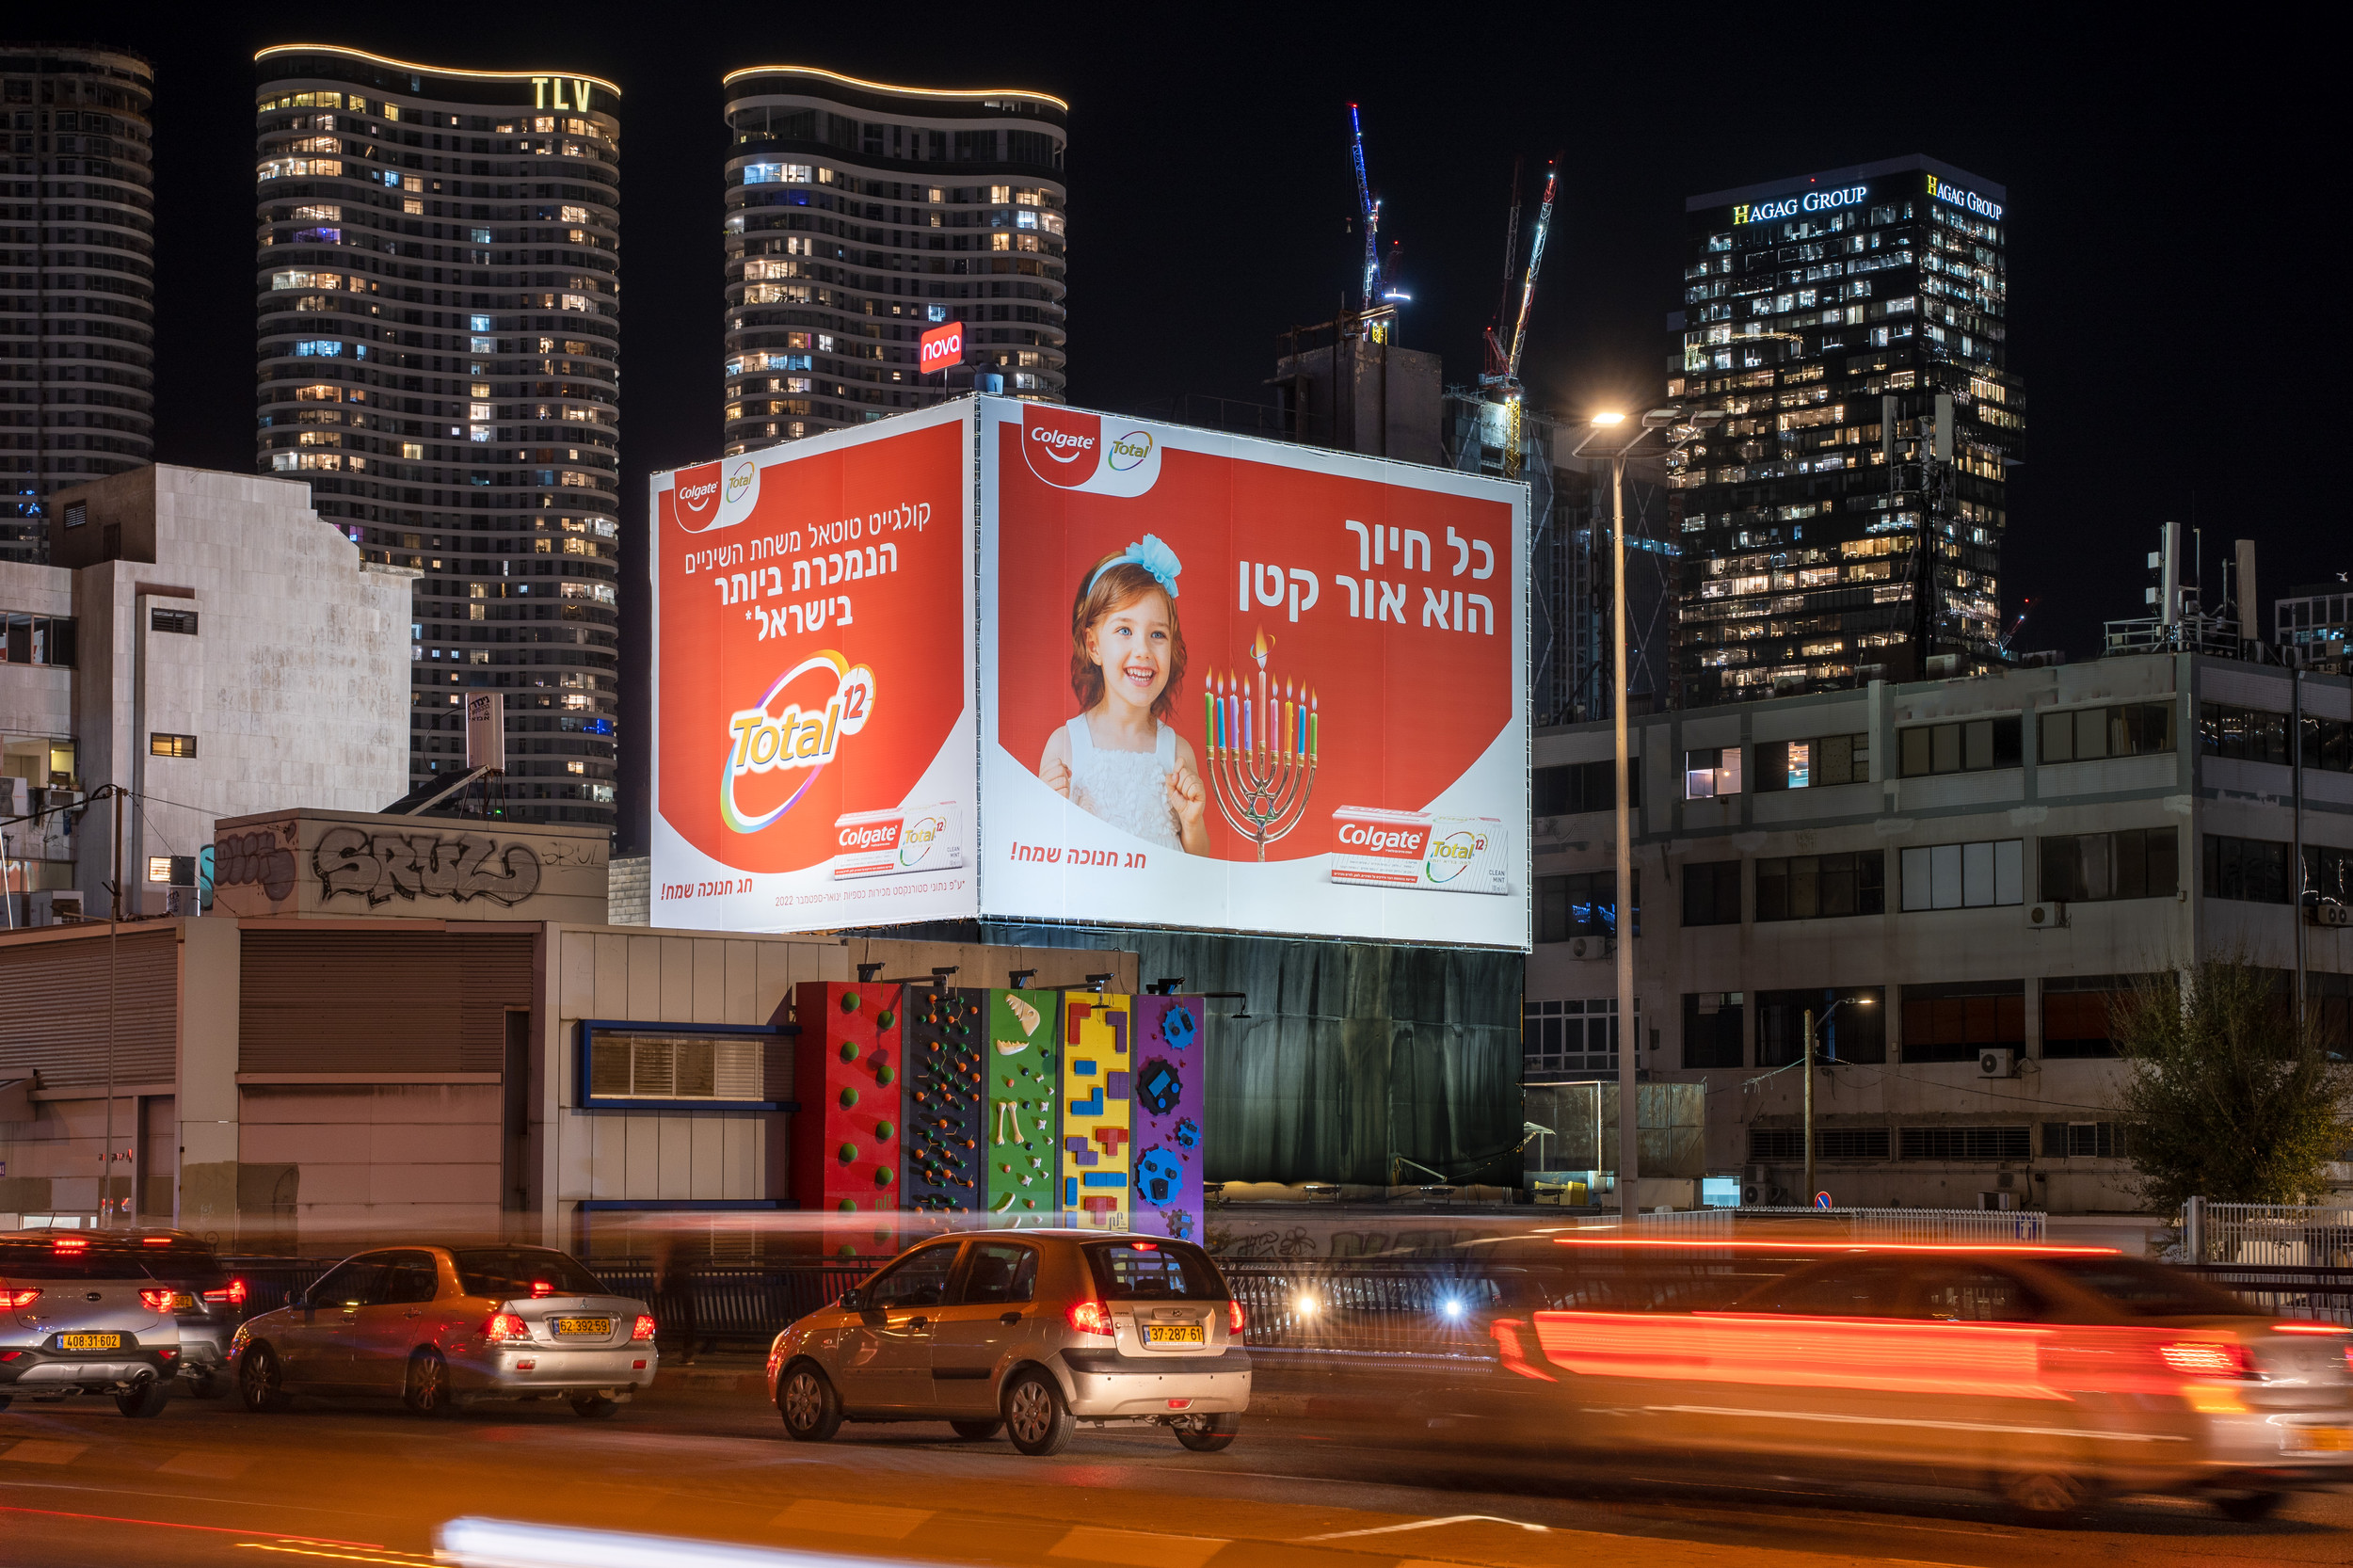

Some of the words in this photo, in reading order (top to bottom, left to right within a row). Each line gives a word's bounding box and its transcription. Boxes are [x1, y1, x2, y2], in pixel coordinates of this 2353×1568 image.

[532, 77, 591, 113] TLV
[1733, 200, 1799, 226] HAGAG
[1802, 186, 1867, 213] GROUP
[1927, 174, 1965, 207] HAGAG
[1966, 191, 2003, 221] GROUP
[922, 334, 960, 362] nova
[1031, 426, 1096, 450] Colgate
[1112, 440, 1151, 459] Total
[679, 481, 719, 501] Colgate
[728, 472, 753, 489] Total
[808, 517, 862, 549] טוטאל
[869, 502, 932, 536] קולגייט
[685, 543, 744, 575] השיניים
[749, 531, 801, 562] משחת
[1345, 520, 1432, 572] חיוך
[1447, 525, 1495, 580] כל
[792, 542, 898, 592] הנמכרת
[714, 566, 783, 606] ביותר
[1239, 560, 1320, 623] קטן
[1336, 574, 1407, 625] אור
[1422, 587, 1495, 635] הוא
[732, 704, 840, 768] Total
[842, 682, 867, 721] 12
[839, 825, 898, 849] Colgate
[904, 827, 936, 844] Total
[936, 822, 944, 832] 12
[1338, 823, 1424, 852] Colgate
[1433, 840, 1475, 859] Total
[1475, 839, 1484, 851] 12
[1010, 841, 1062, 863] שמח!
[1066, 848, 1118, 867] חנוכה
[1124, 853, 1146, 869] חג
[661, 881, 694, 901] שמח!
[697, 880, 733, 897] חנוכה
[738, 877, 753, 893] חג
[843, 889, 867, 901] כספיות
[869, 888, 890, 898] מכירות
[930, 883, 947, 892] נתוני
[775, 896, 793, 907] 2022
